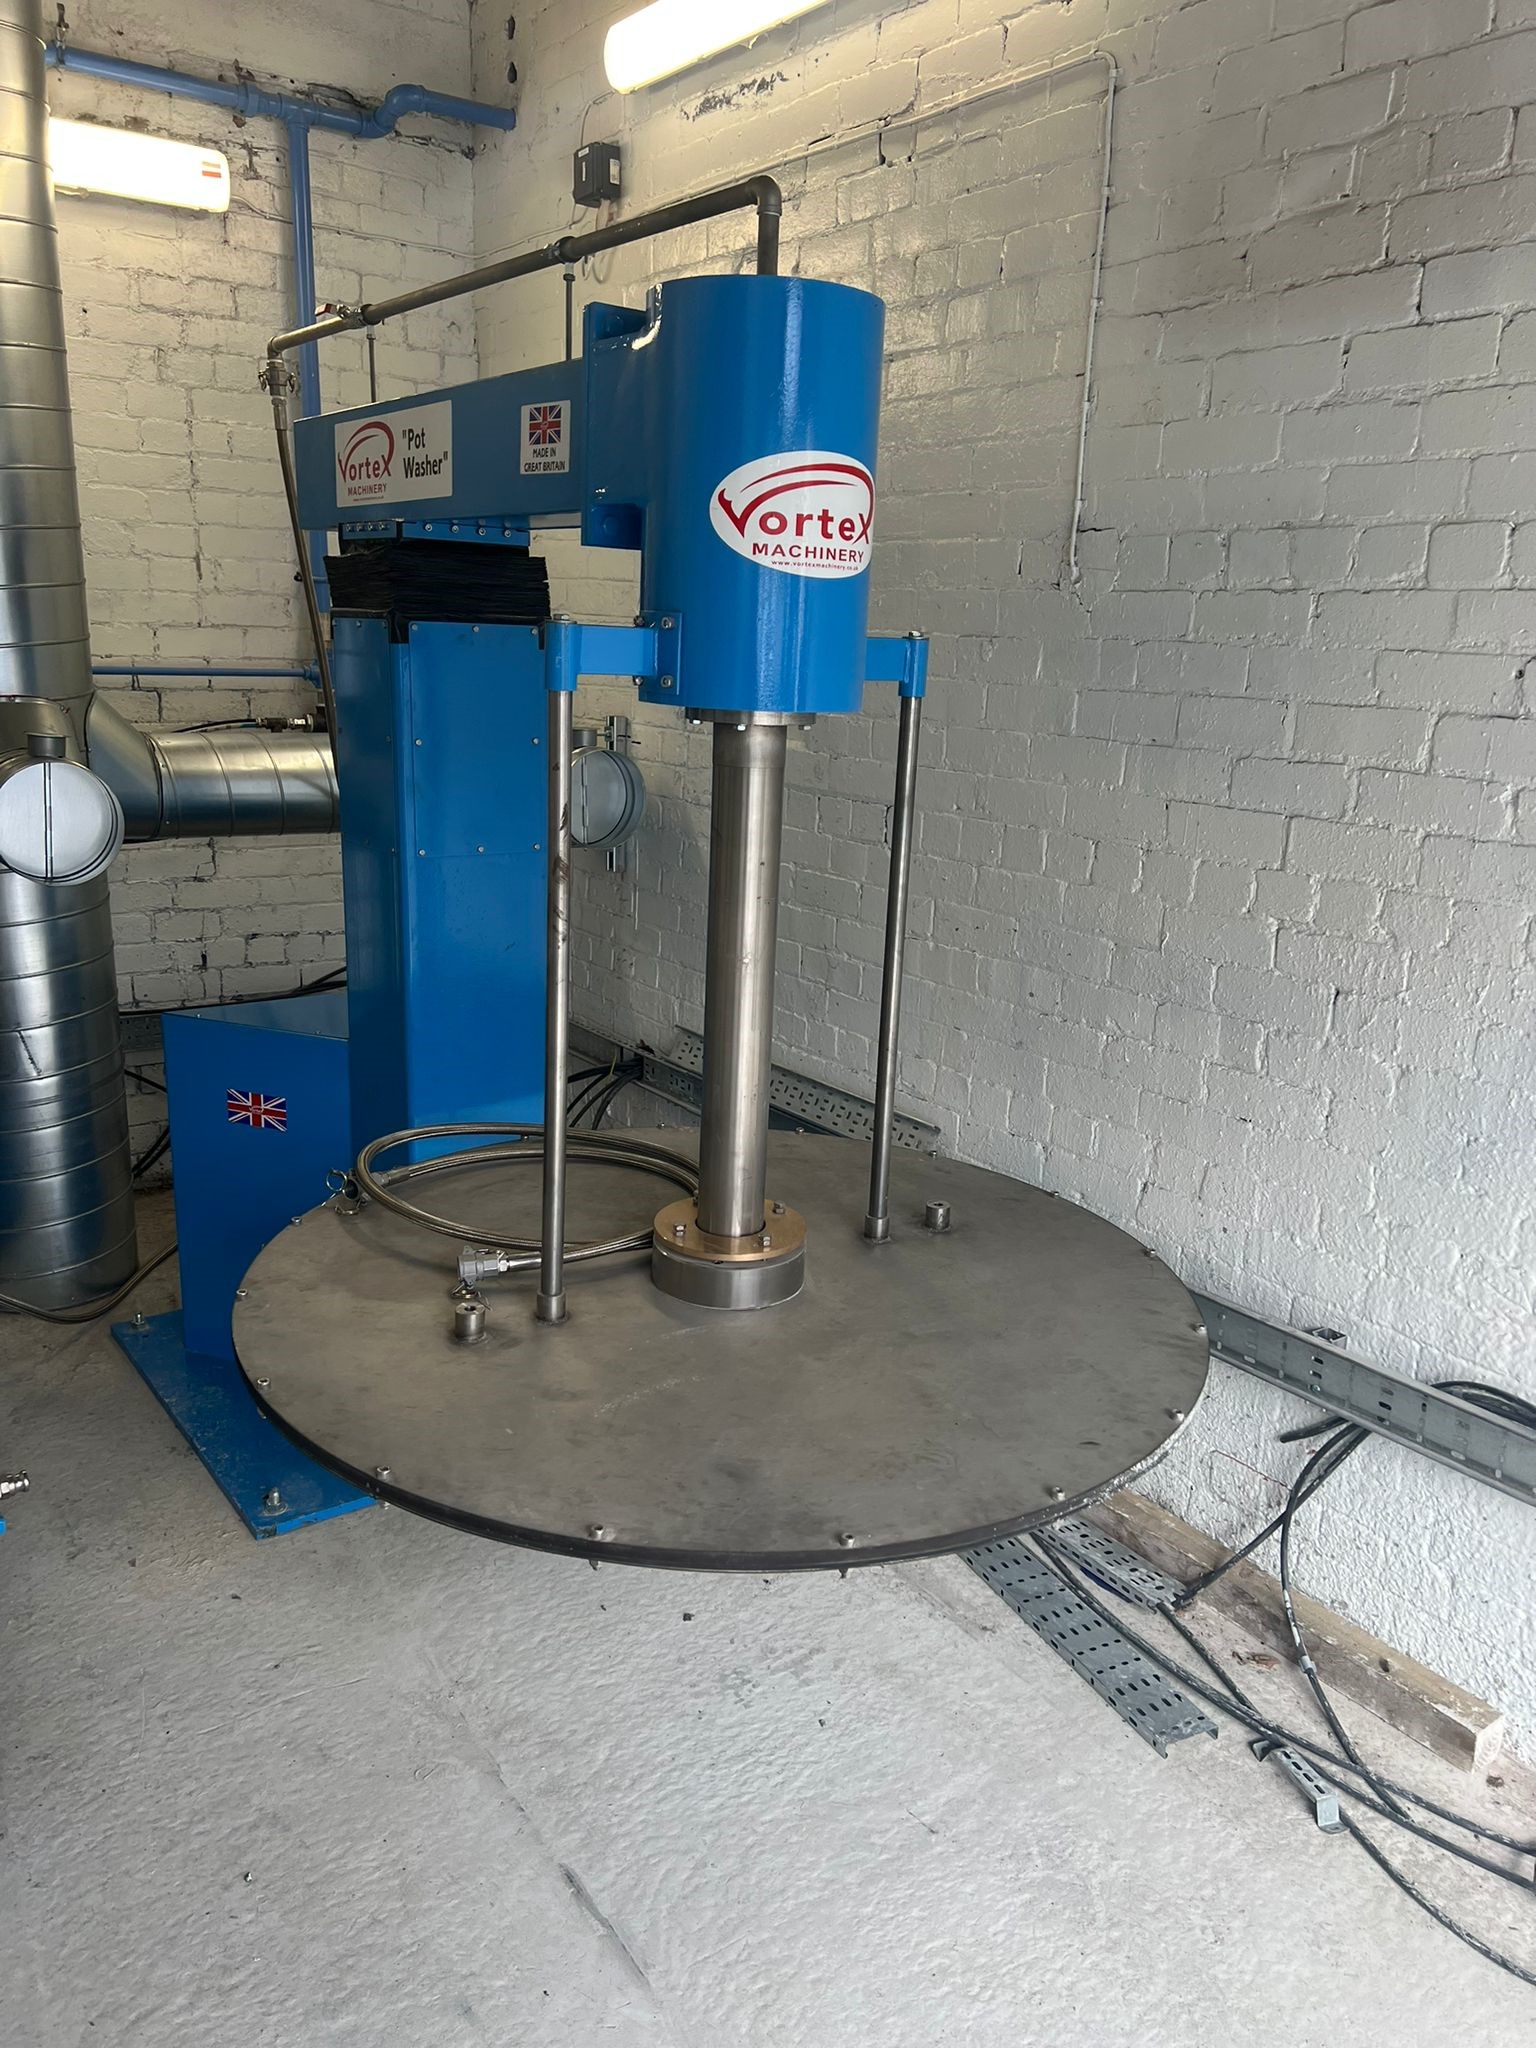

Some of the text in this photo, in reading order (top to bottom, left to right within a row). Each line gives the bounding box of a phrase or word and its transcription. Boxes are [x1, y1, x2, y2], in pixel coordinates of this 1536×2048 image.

[532, 447, 556, 458] MADE IN
[524, 461, 565, 472] GREAT BRITAIN
[347, 483, 387, 496] MACHINERY
[752, 543, 864, 563] MACHINERY
